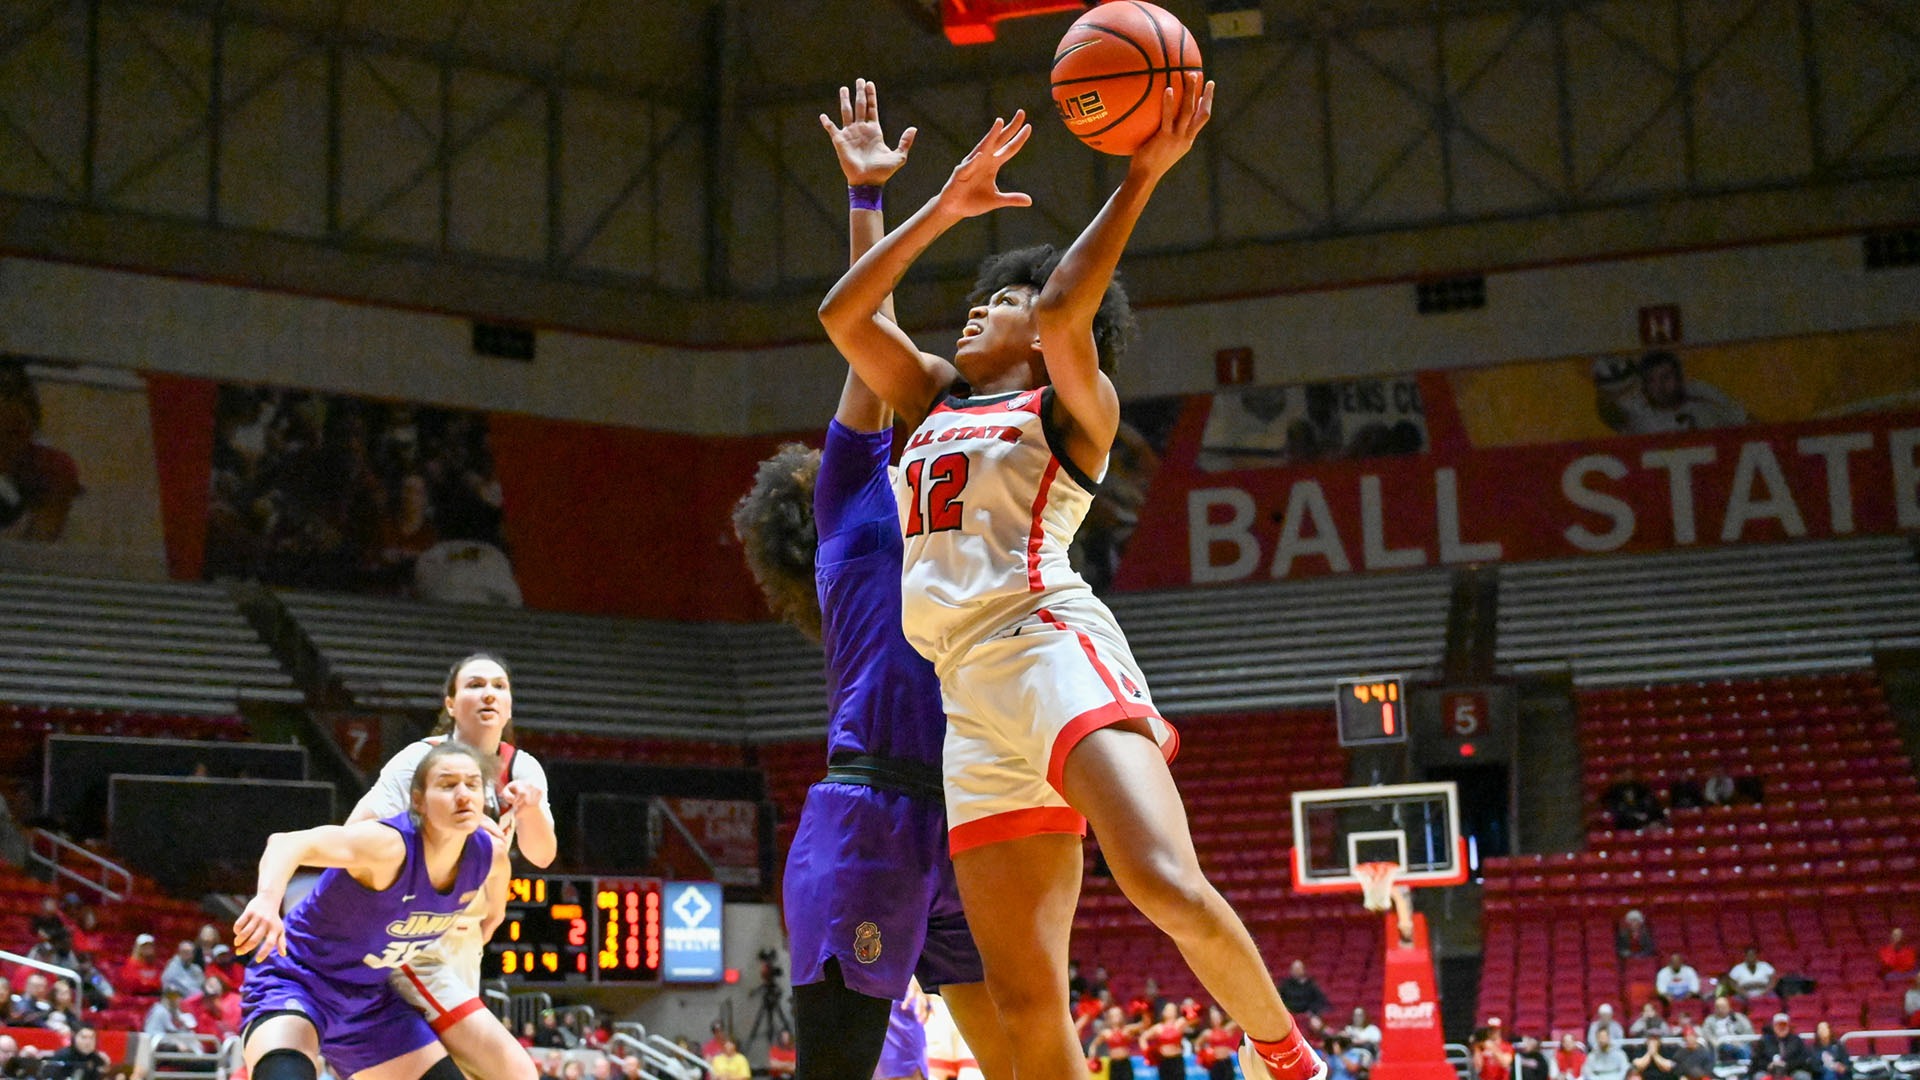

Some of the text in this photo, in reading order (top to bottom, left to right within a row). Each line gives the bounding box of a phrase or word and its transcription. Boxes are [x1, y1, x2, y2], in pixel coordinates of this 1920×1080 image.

[1056, 90, 1105, 120] LITE
[902, 429, 935, 457] LL
[905, 451, 970, 538] 12
[1188, 428, 1920, 584] BALL STATE
[1382, 702, 1395, 735] 1
[1454, 704, 1478, 735] 5
[347, 728, 368, 760] 7
[568, 918, 587, 946] 2
